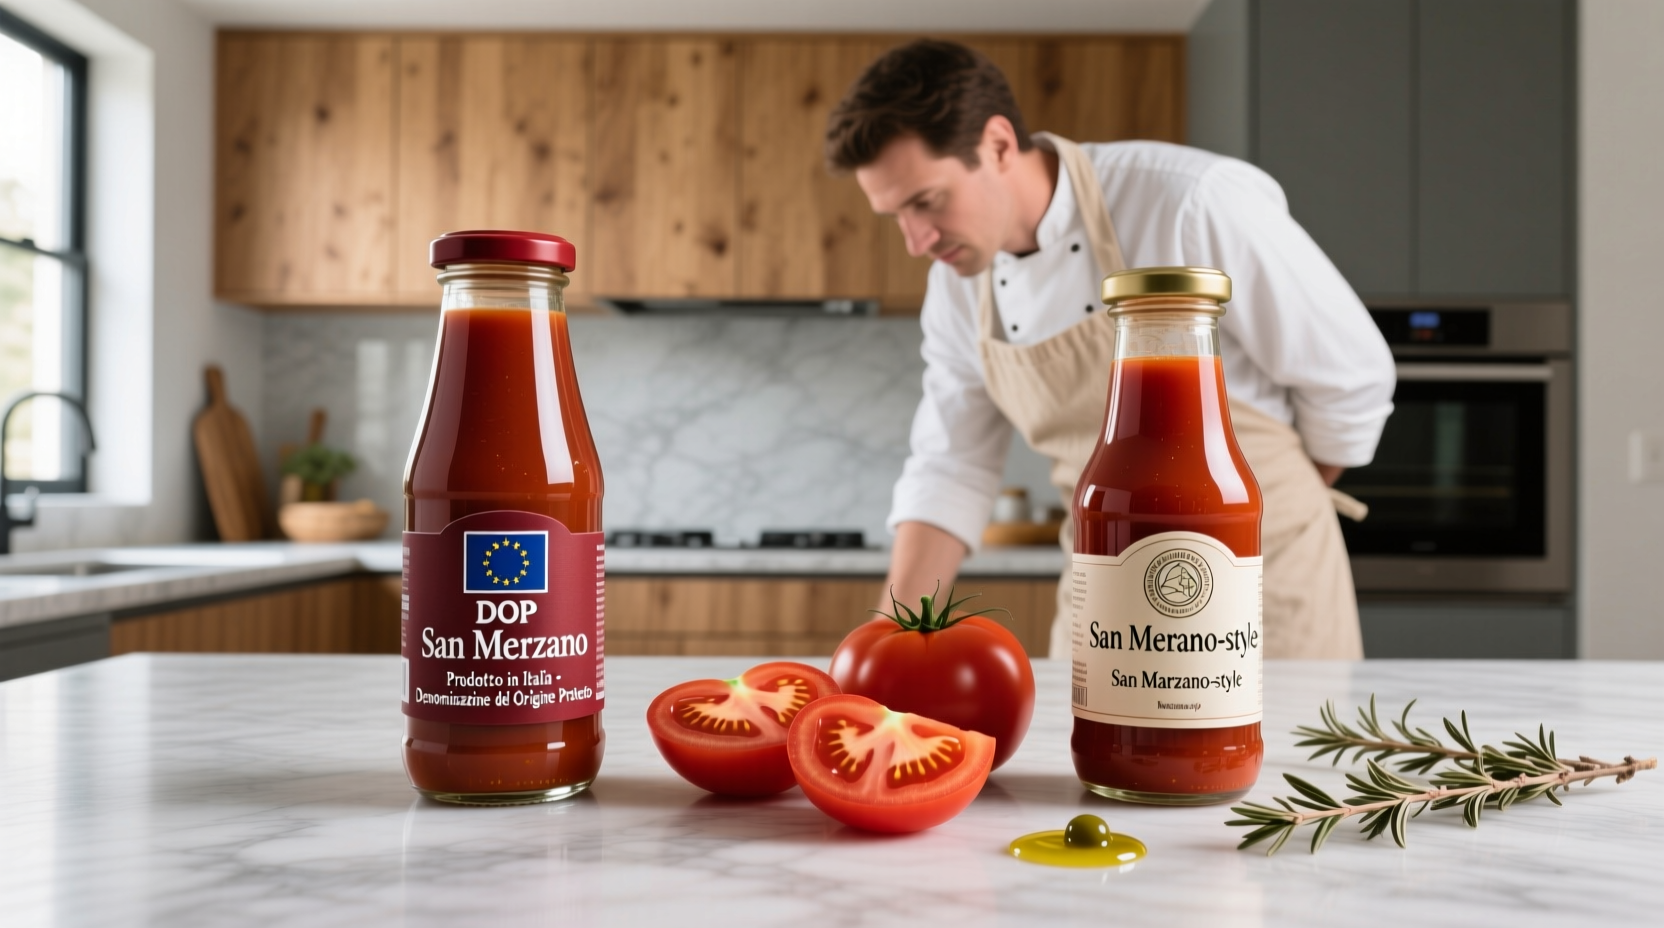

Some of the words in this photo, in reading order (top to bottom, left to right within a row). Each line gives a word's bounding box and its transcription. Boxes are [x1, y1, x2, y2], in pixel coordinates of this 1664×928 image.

[475, 599, 538, 624] DOP
[421, 626, 465, 659] San
[472, 629, 588, 660] Merzano
[1089, 620, 1123, 650] San
[1128, 622, 1258, 658] Merano-style
[507, 671, 519, 687] in
[1111, 668, 1137, 688] San
[1141, 669, 1242, 692] Marzano-style
[513, 689, 556, 709] Origine
